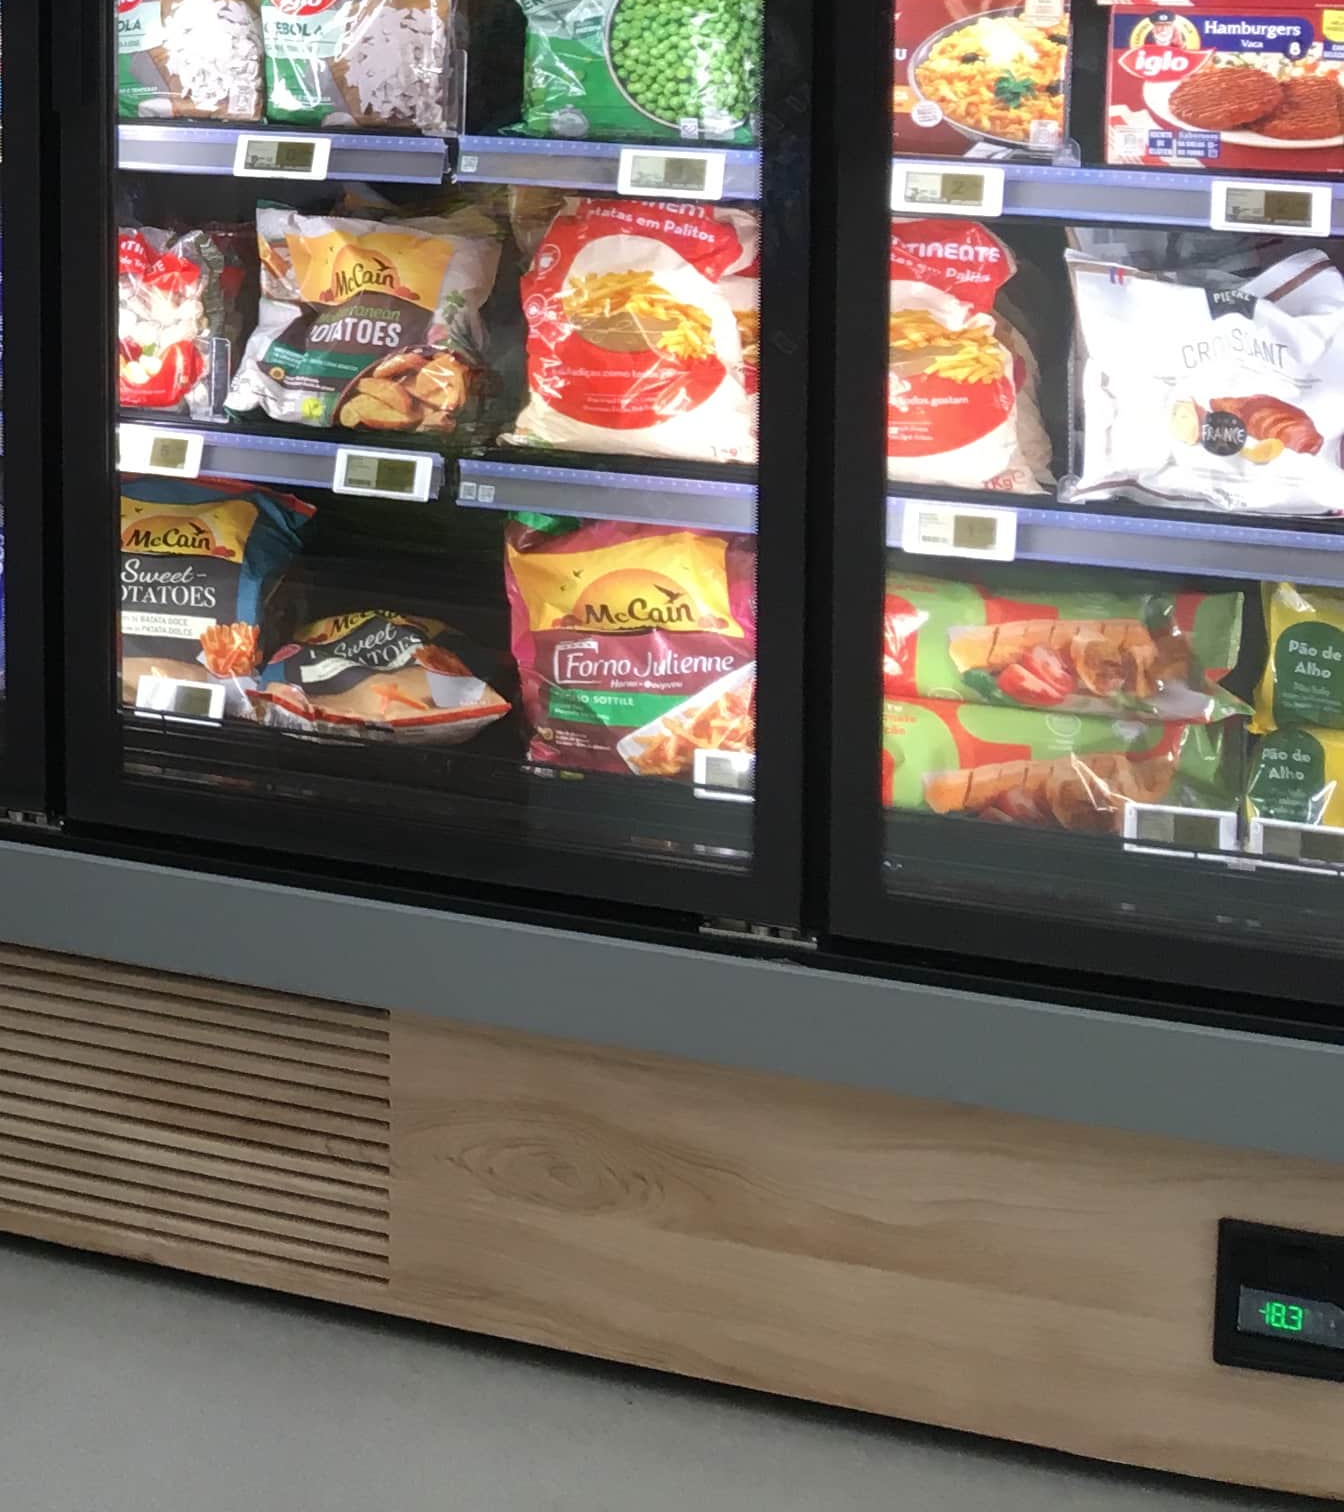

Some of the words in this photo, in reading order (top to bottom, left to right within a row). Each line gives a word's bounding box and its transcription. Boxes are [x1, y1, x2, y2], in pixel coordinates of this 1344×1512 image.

[1204, 21, 1301, 39] Hamburgers
[1241, 39, 1263, 49] Vaca
[1290, 41, 1300, 56] 8
[1135, 49, 1188, 74] iglo
[665, 218, 715, 243] Palitos
[334, 255, 394, 296] McCain
[127, 528, 210, 550] McCain
[586, 593, 693, 626] McCain
[1289, 641, 1316, 659] Pão
[1321, 643, 1340, 659] de
[566, 650, 631, 677] Forno
[634, 650, 734, 677] Julienne
[1295, 660, 1331, 680] Alho
[1262, 748, 1289, 762] Pão
[1269, 766, 1303, 781] Alho
